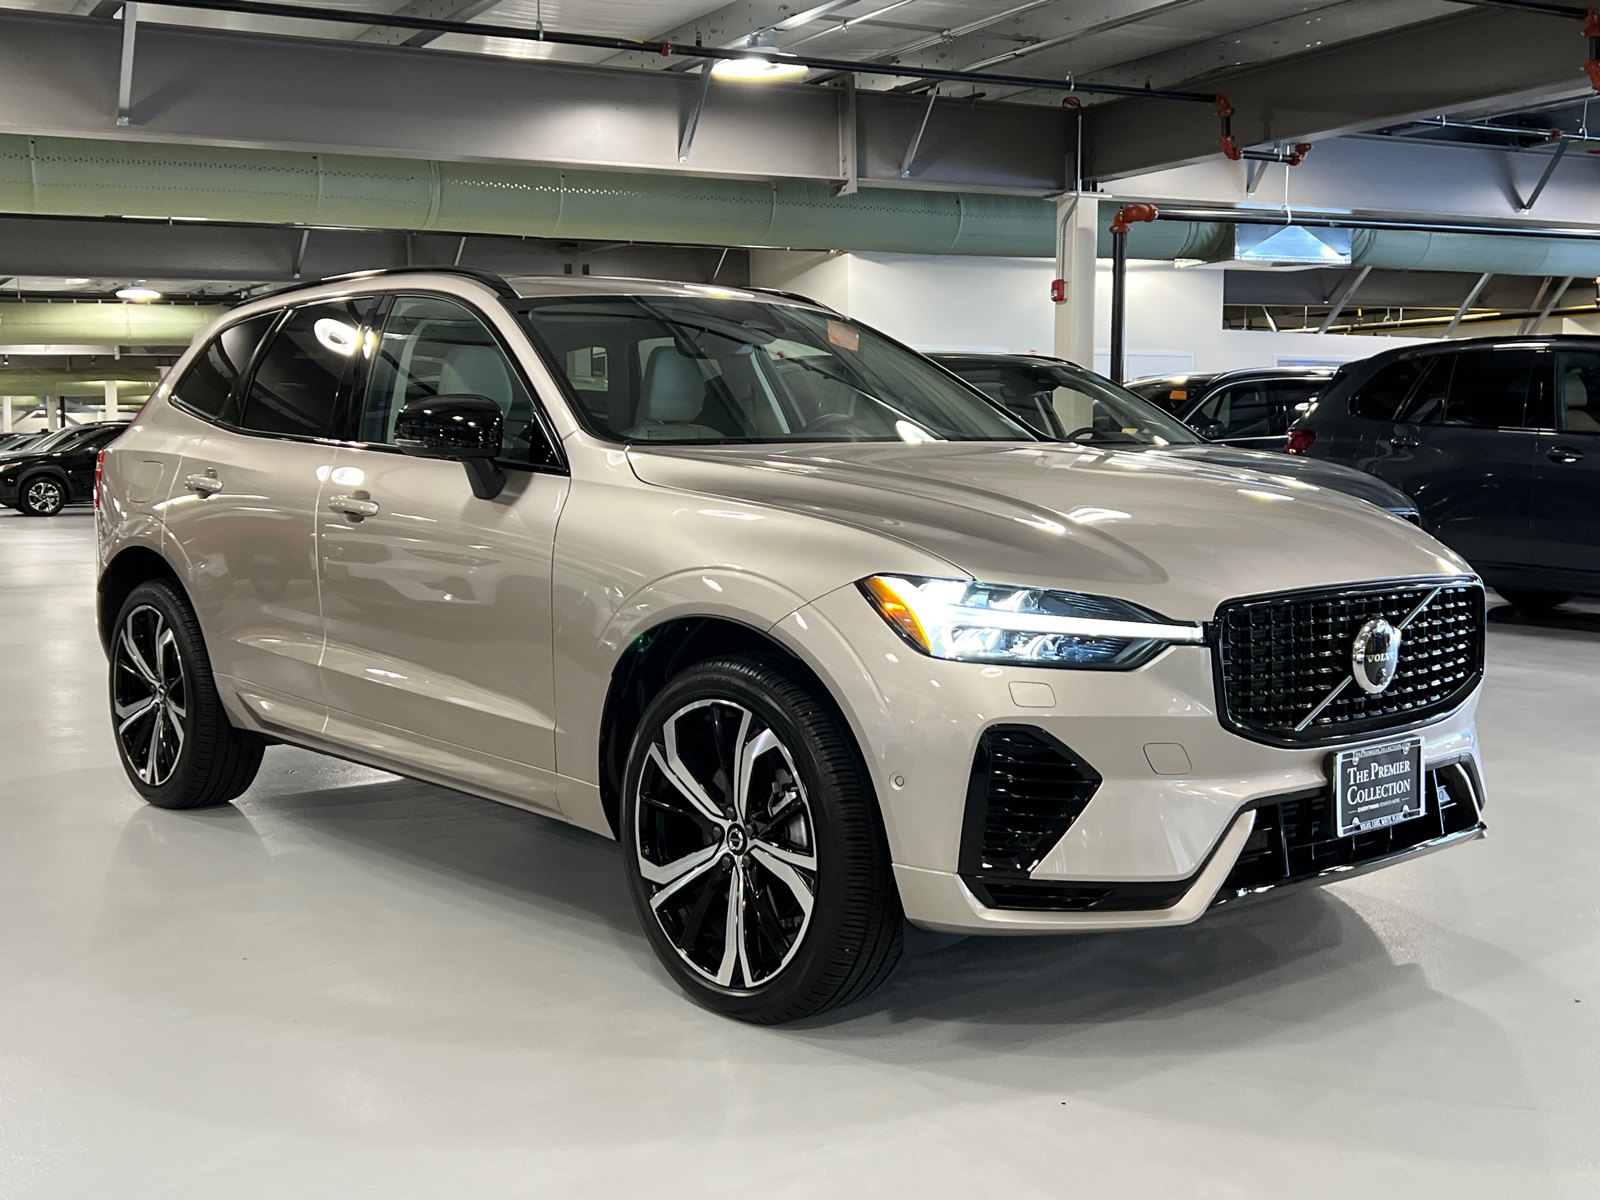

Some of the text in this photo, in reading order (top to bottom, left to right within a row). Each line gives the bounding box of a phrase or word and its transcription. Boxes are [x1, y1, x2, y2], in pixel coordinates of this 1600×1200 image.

[1347, 760, 1411, 785] THE PREMIER
[1347, 779, 1411, 805] COLLECTION
